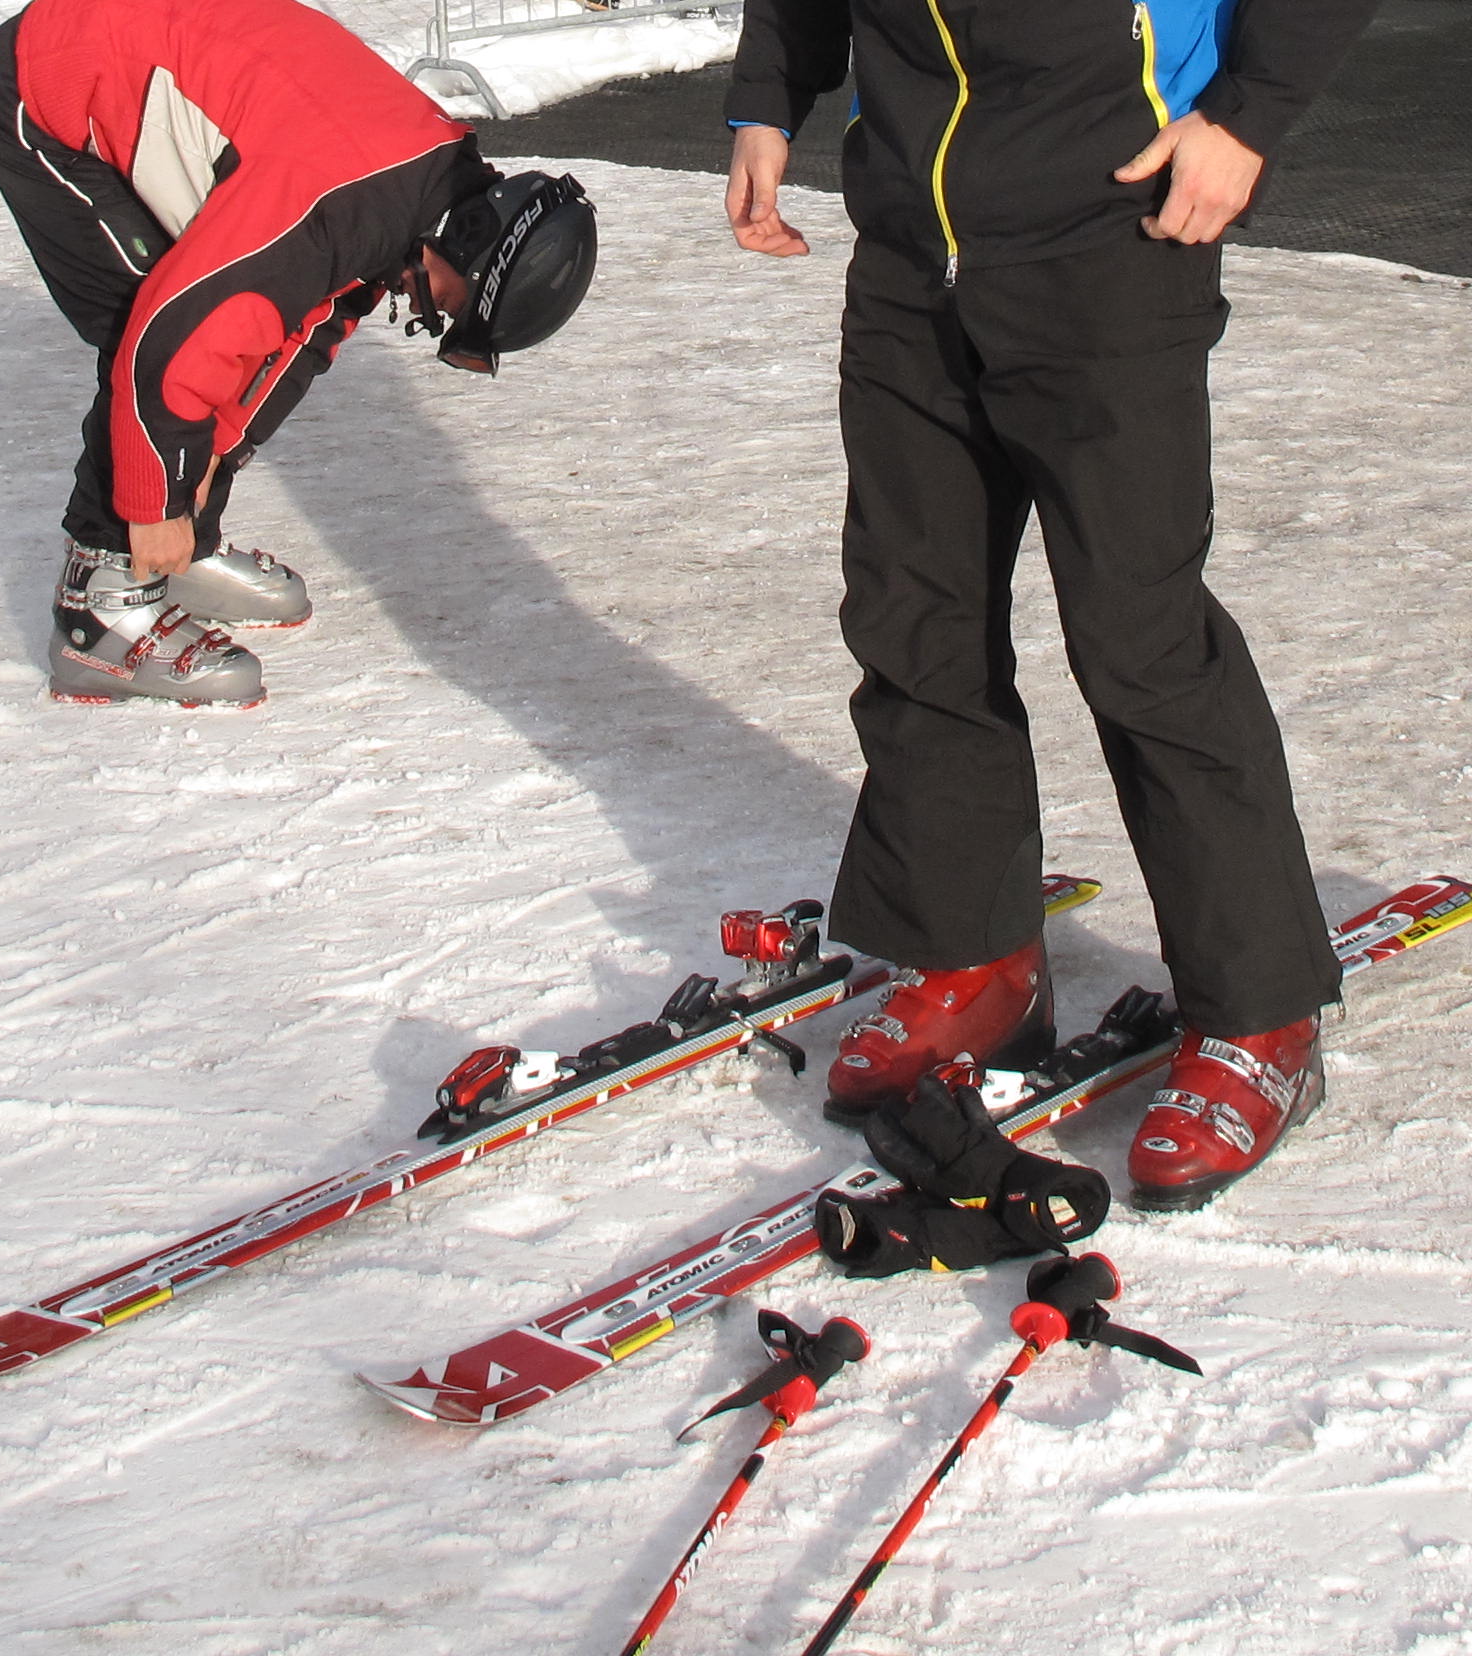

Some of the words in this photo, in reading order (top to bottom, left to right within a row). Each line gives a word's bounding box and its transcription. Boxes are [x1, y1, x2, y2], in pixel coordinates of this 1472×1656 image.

[478, 198, 544, 321] FISCHER
[1402, 922, 1442, 942] SL
[151, 1233, 237, 1275] ATOMIC
[647, 1254, 726, 1300] ATOMIC
